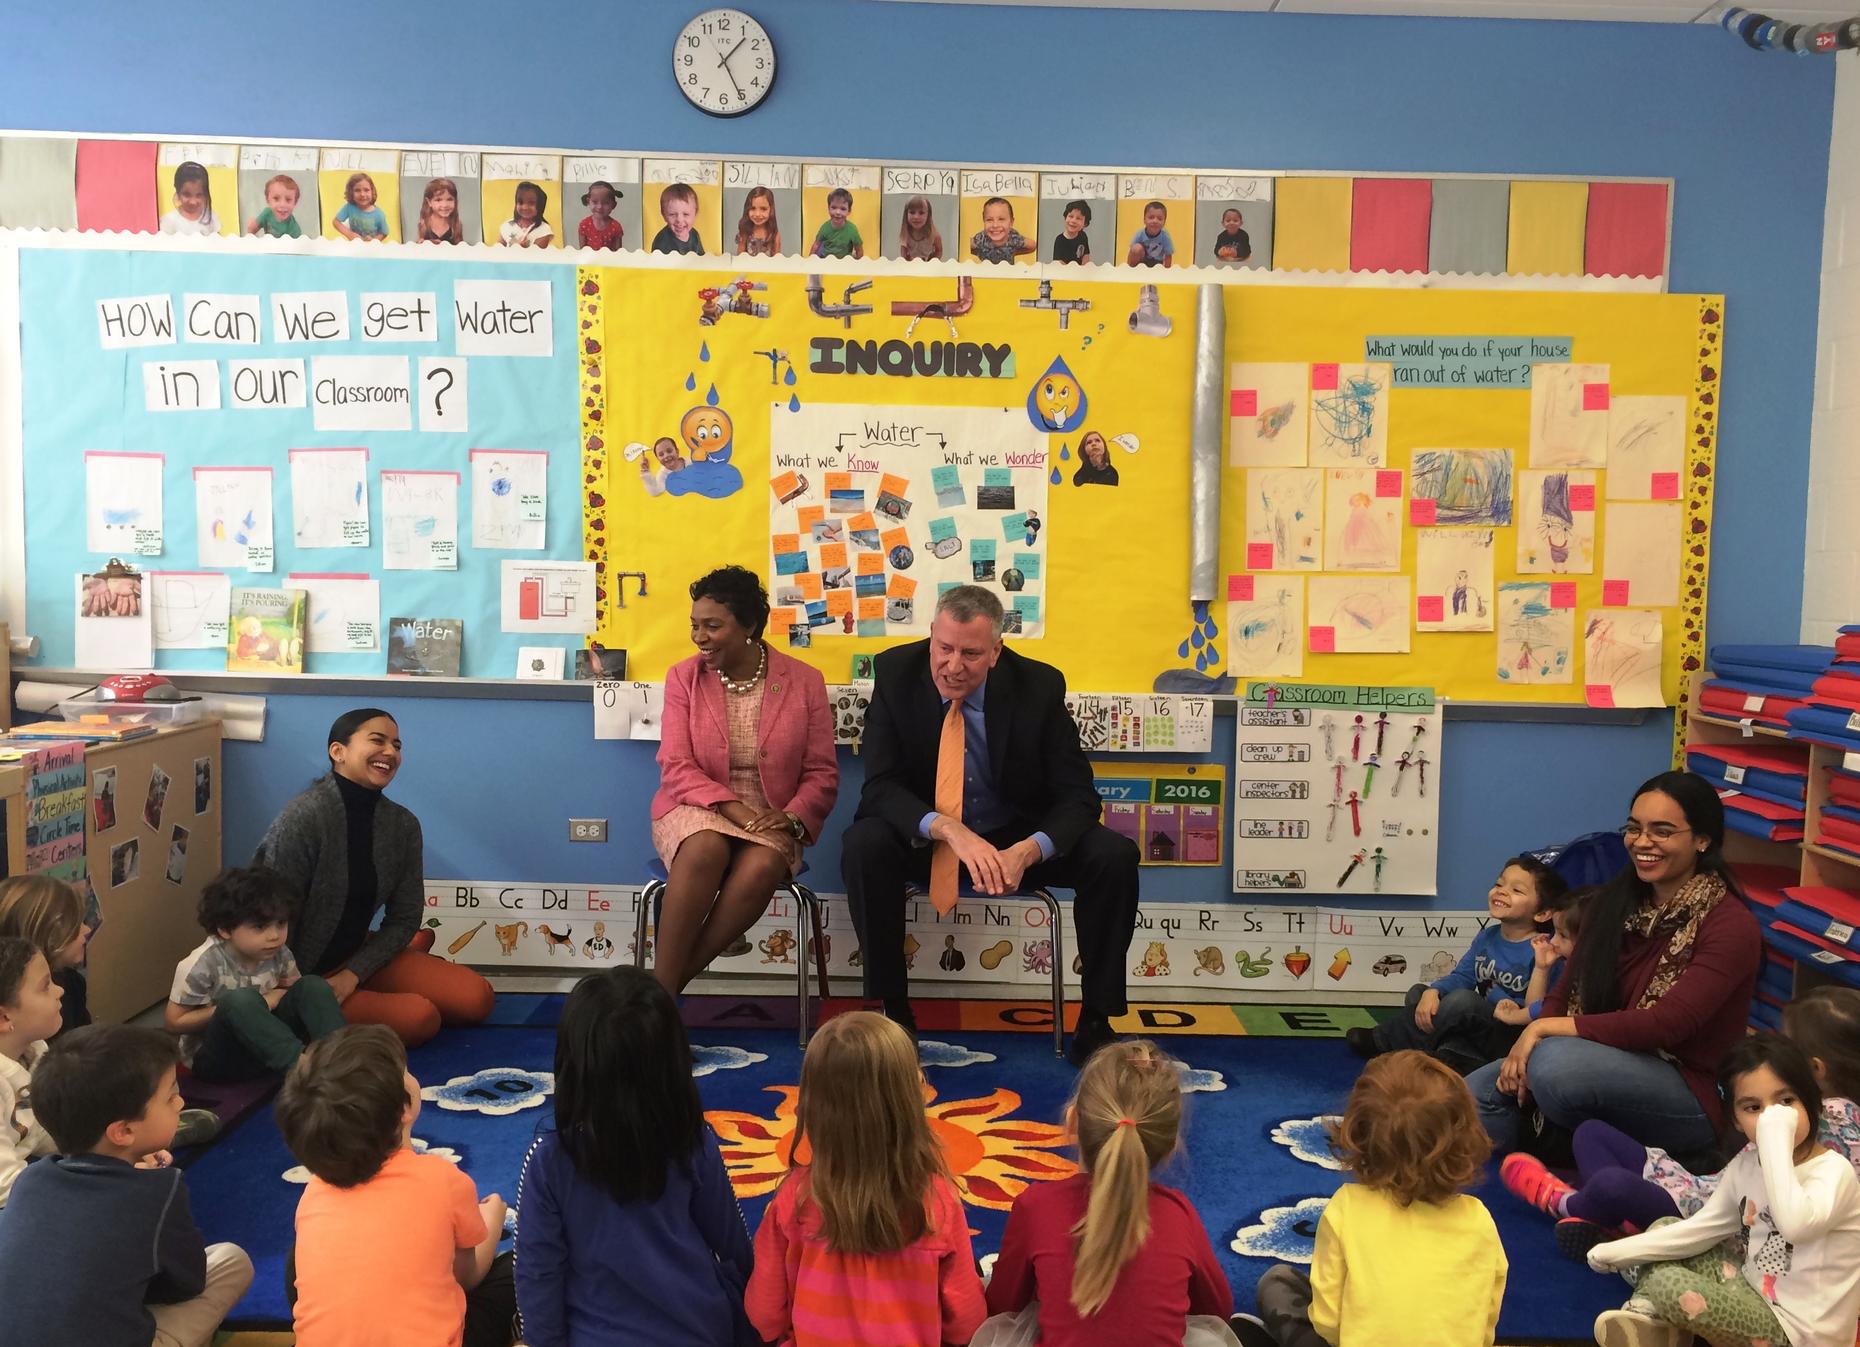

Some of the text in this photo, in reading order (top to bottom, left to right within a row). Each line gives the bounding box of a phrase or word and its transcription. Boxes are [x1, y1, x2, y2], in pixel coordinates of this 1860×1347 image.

[702, 24, 712, 34] 11
[718, 18, 730, 30] 12
[740, 25, 745, 36] 1
[687, 36, 700, 48] 10
[751, 39, 760, 50] 2
[684, 55, 693, 66] 9
[756, 58, 764, 69] 3
[688, 73, 698, 85] 8
[750, 76, 759, 88] 4
[702, 88, 710, 98] 7
[719, 93, 728, 104] 6
[738, 89, 746, 100] 5
[188, 300, 257, 342] Can
[280, 303, 340, 340] We
[363, 298, 431, 338] get
[456, 299, 544, 335] Water
[1366, 338, 1570, 361] What would you do if your house
[810, 336, 1012, 378] INQUIRY
[1393, 364, 1531, 383] ran out of water ?
[160, 366, 455, 416] in our Classroom ?
[864, 421, 924, 443] Water
[776, 453, 880, 471] What we Know
[944, 451, 1049, 465] What we Wonder
[401, 621, 453, 641] Water
[596, 681, 621, 689] Zero
[603, 688, 616, 708] 0
[643, 689, 648, 705] 1
[846, 693, 859, 706] 7
[1252, 683, 1427, 710] Cassroom Helpers
[1083, 700, 1100, 714] 14
[1118, 700, 1134, 715] 15
[1153, 701, 1170, 716] 16
[1190, 702, 1205, 717] 17
[1248, 717, 1288, 725] assistant
[1246, 744, 1283, 753] clean up
[43, 747, 75, 773] Arrival
[1253, 752, 1277, 761] crew
[1095, 786, 1131, 799] ary
[1164, 784, 1211, 798] 2016
[1245, 789, 1289, 798] inspectors
[38, 793, 86, 822] Breakfast
[1114, 805, 1131, 813] Friday
[64, 815, 81, 838] Time
[1248, 828, 1274, 837] leader
[456, 886, 480, 908] Bb
[499, 888, 524, 909] Cc
[542, 889, 568, 910] Dd
[588, 890, 611, 911] Ee
[984, 904, 1010, 926] Nn
[1160, 918, 1181, 939] qu
[1199, 909, 1220, 931] Rr
[1243, 911, 1263, 932] Ss
[1282, 912, 1306, 933] Tt
[1329, 914, 1354, 936] Uu
[1378, 916, 1405, 937] Vv
[1422, 916, 1460, 938] Ww
[711, 1002, 776, 1022] A
[999, 1008, 1054, 1026] C
[1137, 1009, 1197, 1028] D
[1278, 1011, 1342, 1031] E
